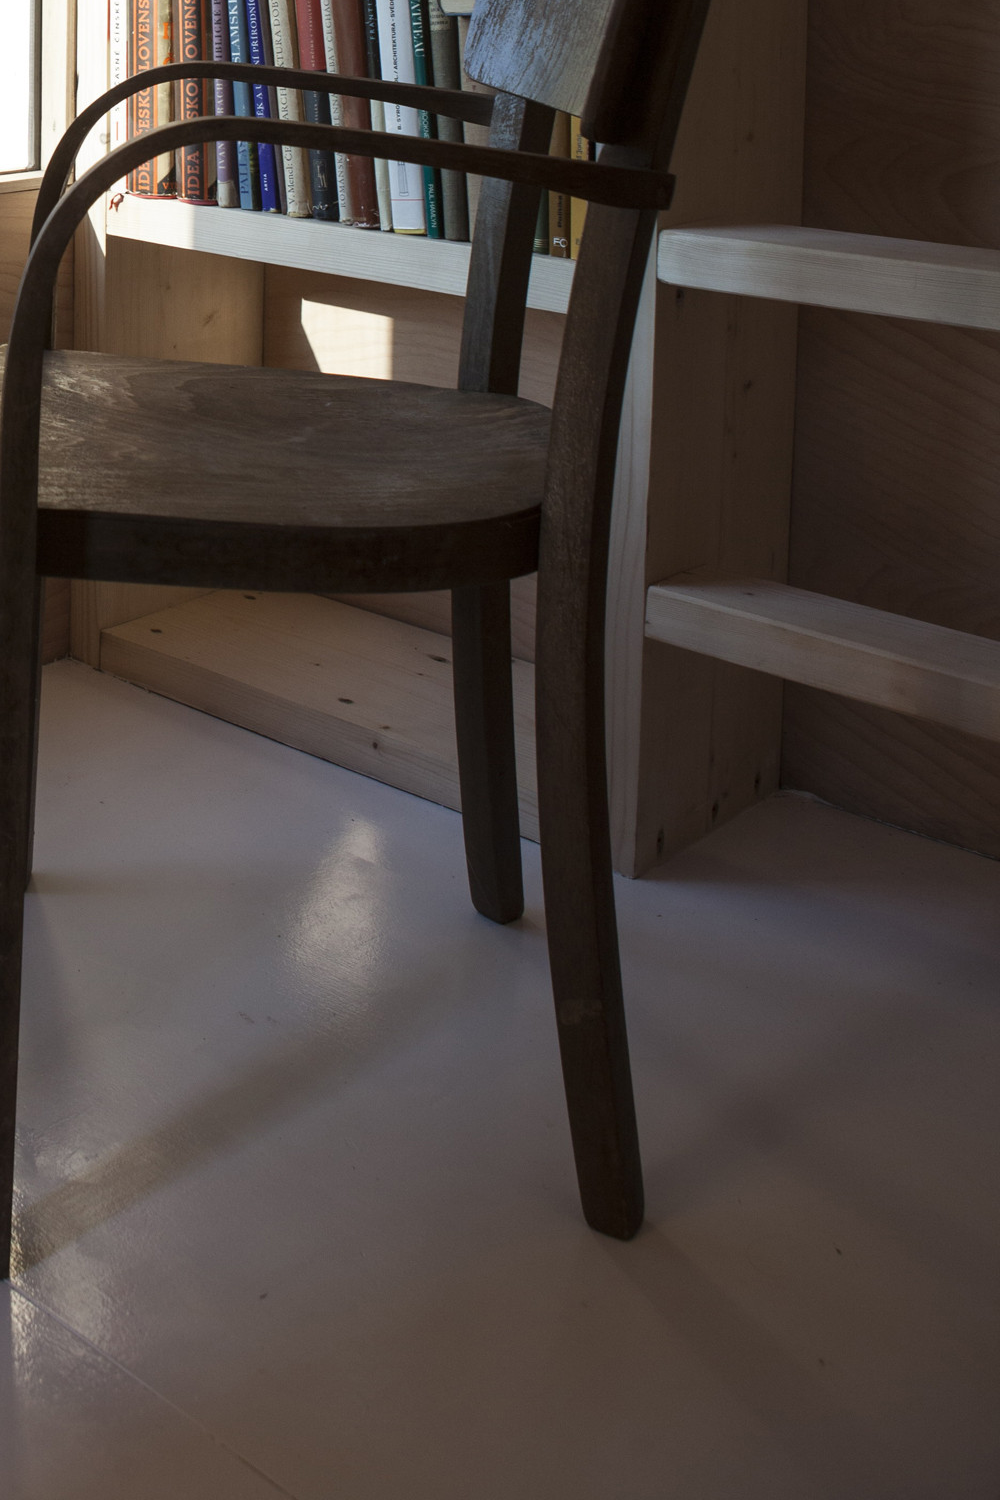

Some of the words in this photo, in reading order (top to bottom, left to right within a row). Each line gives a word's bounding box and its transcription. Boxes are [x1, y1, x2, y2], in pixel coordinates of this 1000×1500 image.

[112, 0, 120, 43] ČÍNSKÉ
[211, 9, 223, 62] IBLICKÉ
[390, 23, 398, 70] ARCHITEKTURA
[255, 92, 263, 100] A
[216, 143, 226, 170] IVAN
[138, 161, 151, 191] IDE
[188, 151, 201, 196] IDEA
[286, 163, 295, 192] Mencl:
[289, 195, 296, 205] V.
[427, 183, 435, 200] PAUL
[428, 201, 438, 228] HAMLYN
